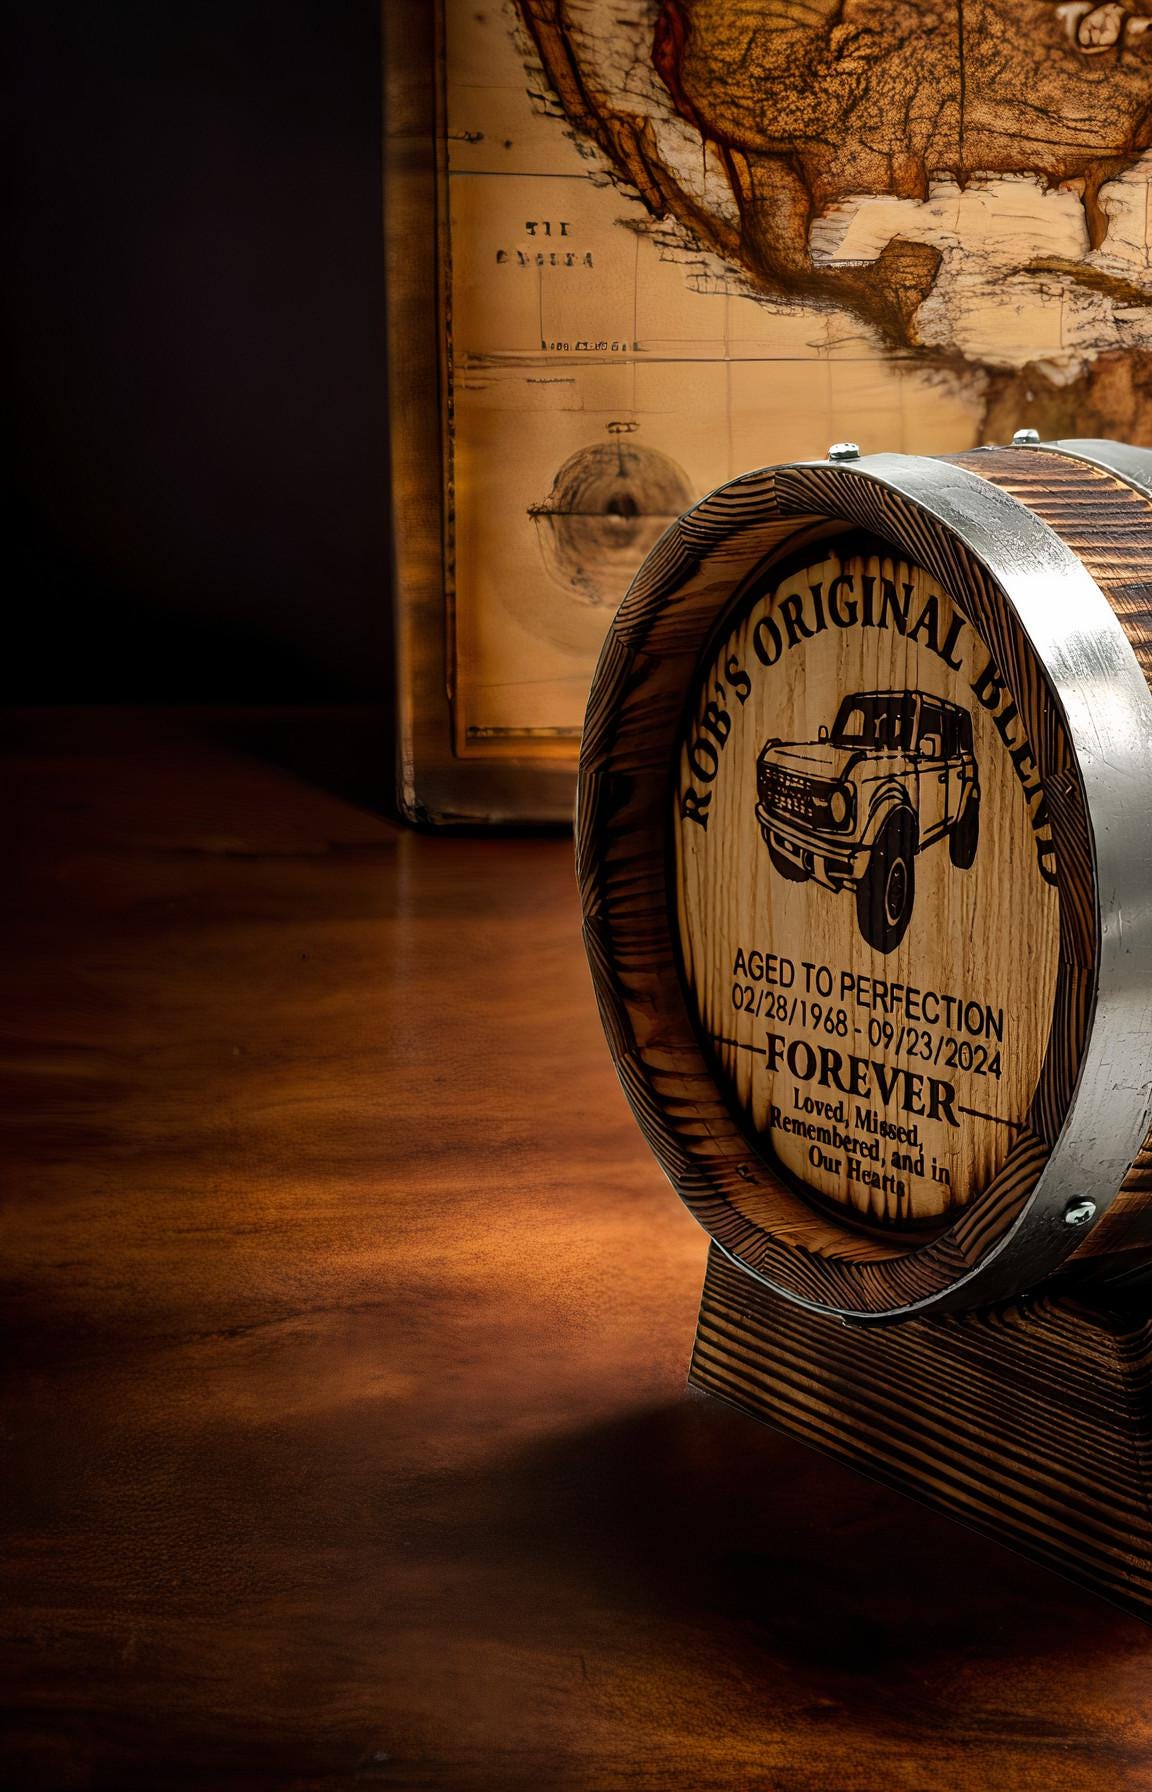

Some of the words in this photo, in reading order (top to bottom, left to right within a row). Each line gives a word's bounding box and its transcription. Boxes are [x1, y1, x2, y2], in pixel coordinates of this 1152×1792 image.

[681, 654, 751, 832] ROB'S
[752, 574, 967, 671] ORIGINAL
[732, 982, 848, 1037] 02/28/1968
[868, 1017, 1002, 1080] 09/23/2024
[734, 948, 795, 988] AGED
[802, 961, 833, 998] TO
[840, 971, 1003, 1042] PERFECTION
[765, 1031, 960, 1128] FOREVER
[793, 1087, 849, 1129] Loved,
[855, 1106, 923, 1155] Missed,
[769, 1104, 886, 1168] Remembered,
[891, 1151, 925, 1178] and
[931, 1157, 951, 1186] in
[809, 1145, 842, 1175] Our
[847, 1156, 905, 1198] Hearts
